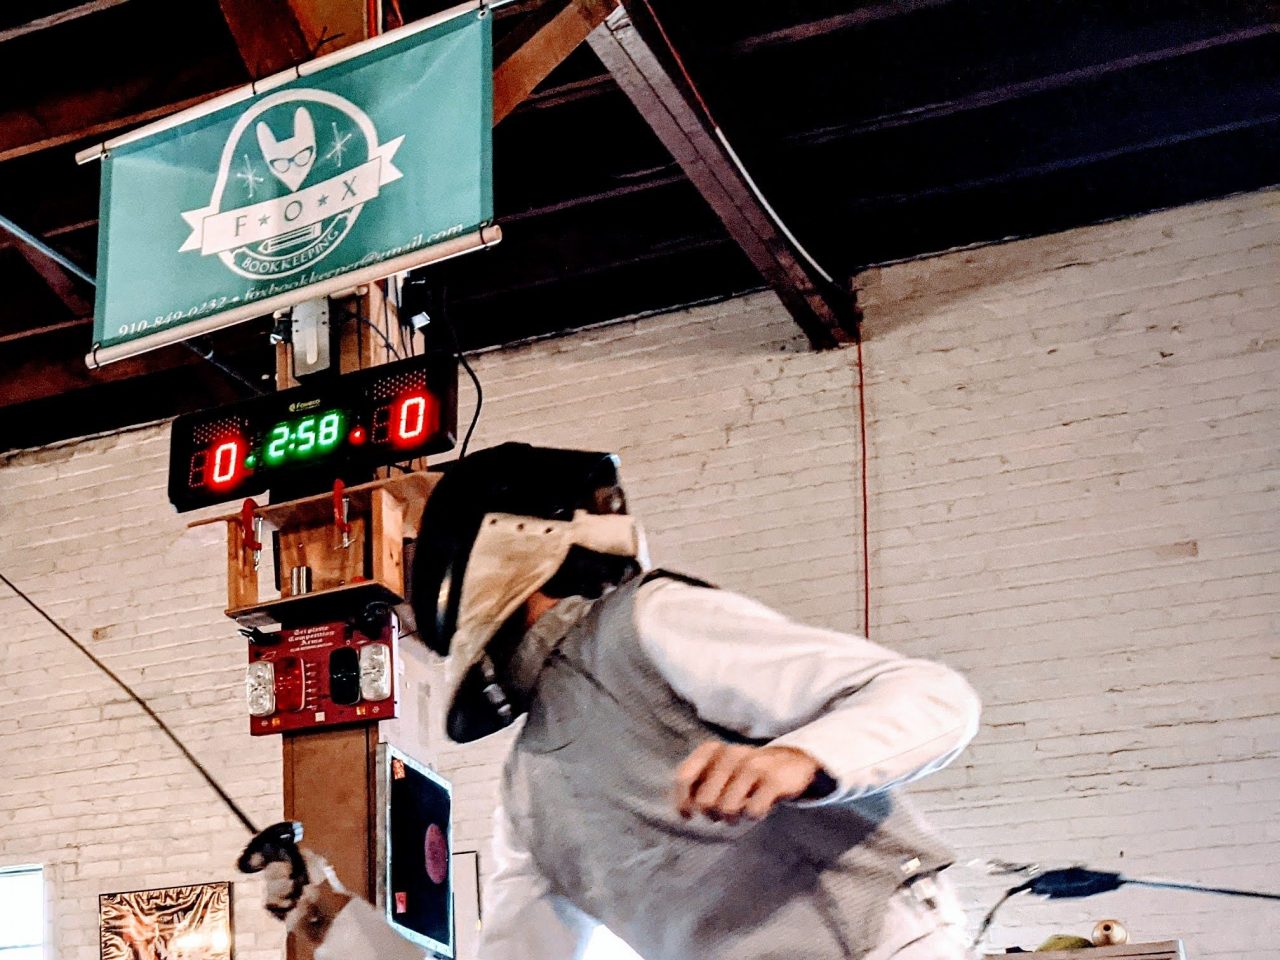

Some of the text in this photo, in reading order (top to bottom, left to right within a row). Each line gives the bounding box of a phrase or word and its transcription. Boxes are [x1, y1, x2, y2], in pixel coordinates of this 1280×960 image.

[240, 229, 340, 273] BOOKKEEPING
[268, 412, 340, 458] 2:58
[399, 396, 426, 439] 0
[213, 441, 238, 483] 0
